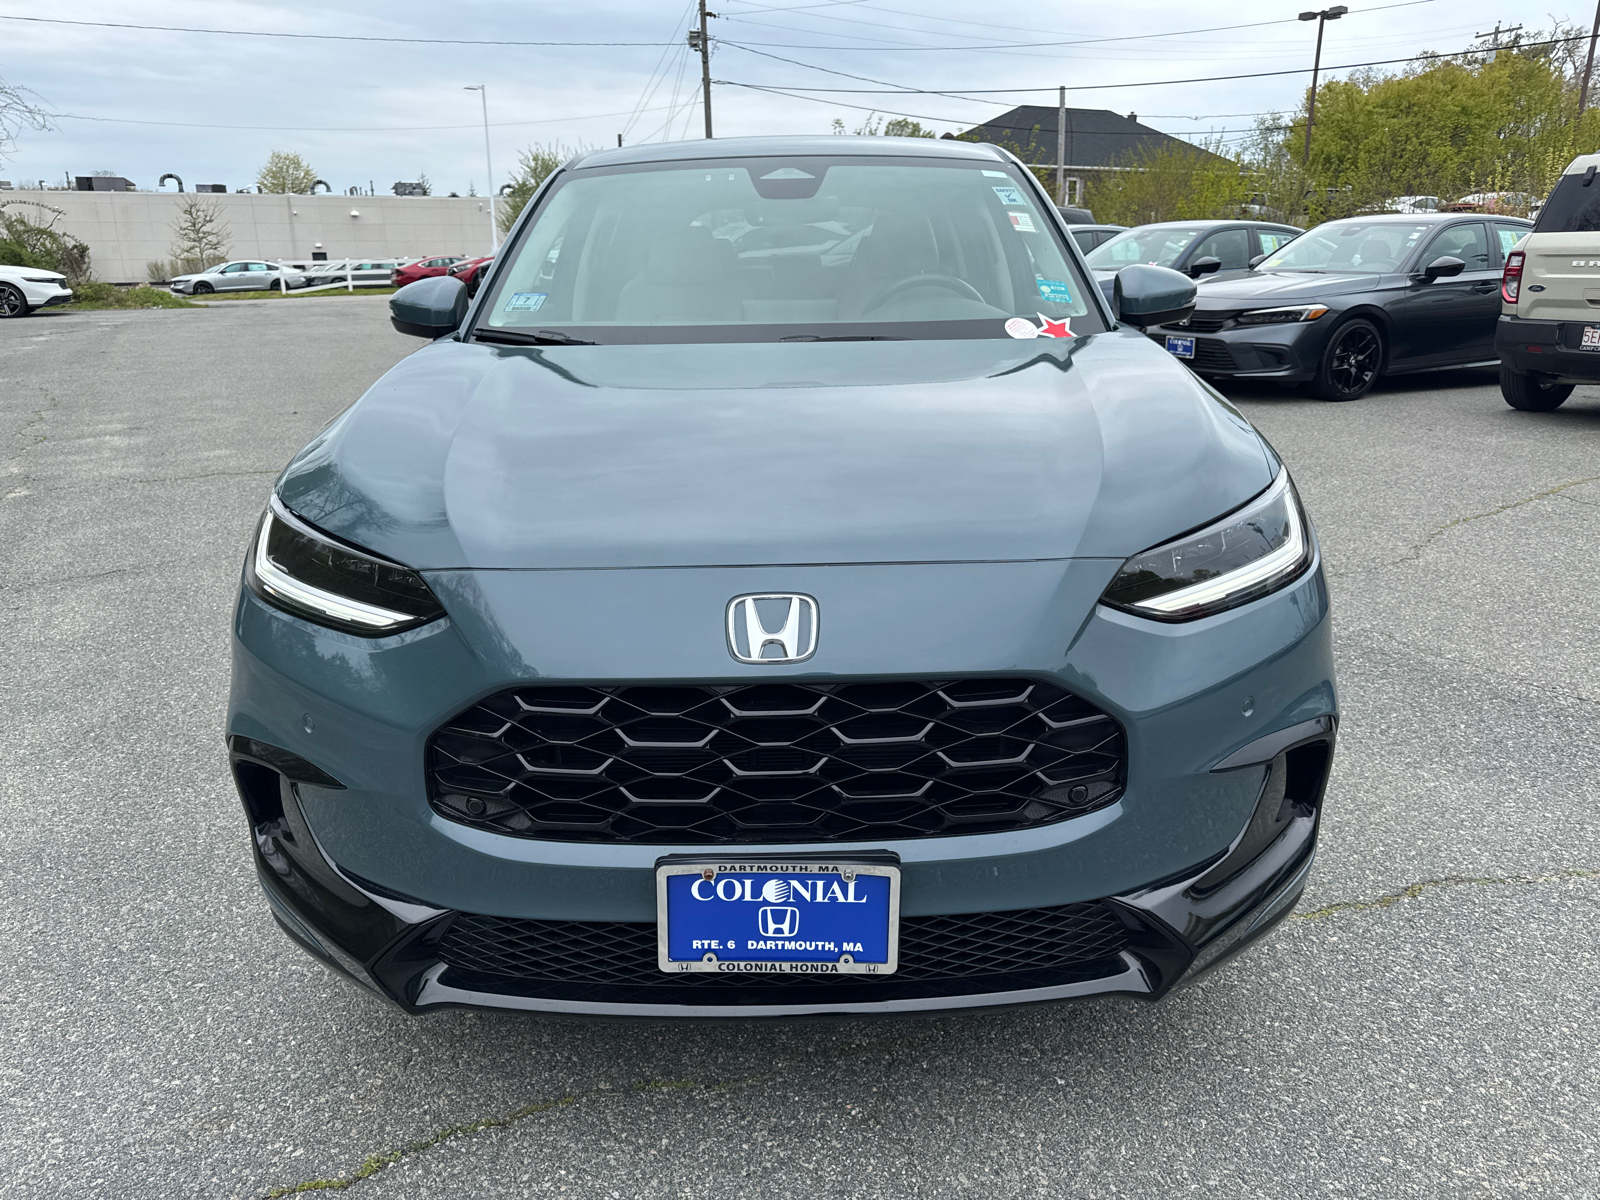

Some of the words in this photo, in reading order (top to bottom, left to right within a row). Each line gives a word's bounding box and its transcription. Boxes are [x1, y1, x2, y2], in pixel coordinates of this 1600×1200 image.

[1583, 331, 1600, 344] 5E
[718, 865, 813, 873] DARTMOUTH,
[818, 865, 840, 873] MA
[690, 878, 868, 904] COLONIAL
[692, 940, 723, 949] RTE.
[727, 940, 736, 949] 6
[747, 940, 839, 953] DARTMOUTH,
[842, 942, 864, 952] MA
[718, 962, 786, 973] COLONIAL
[789, 963, 839, 973] HONDA
